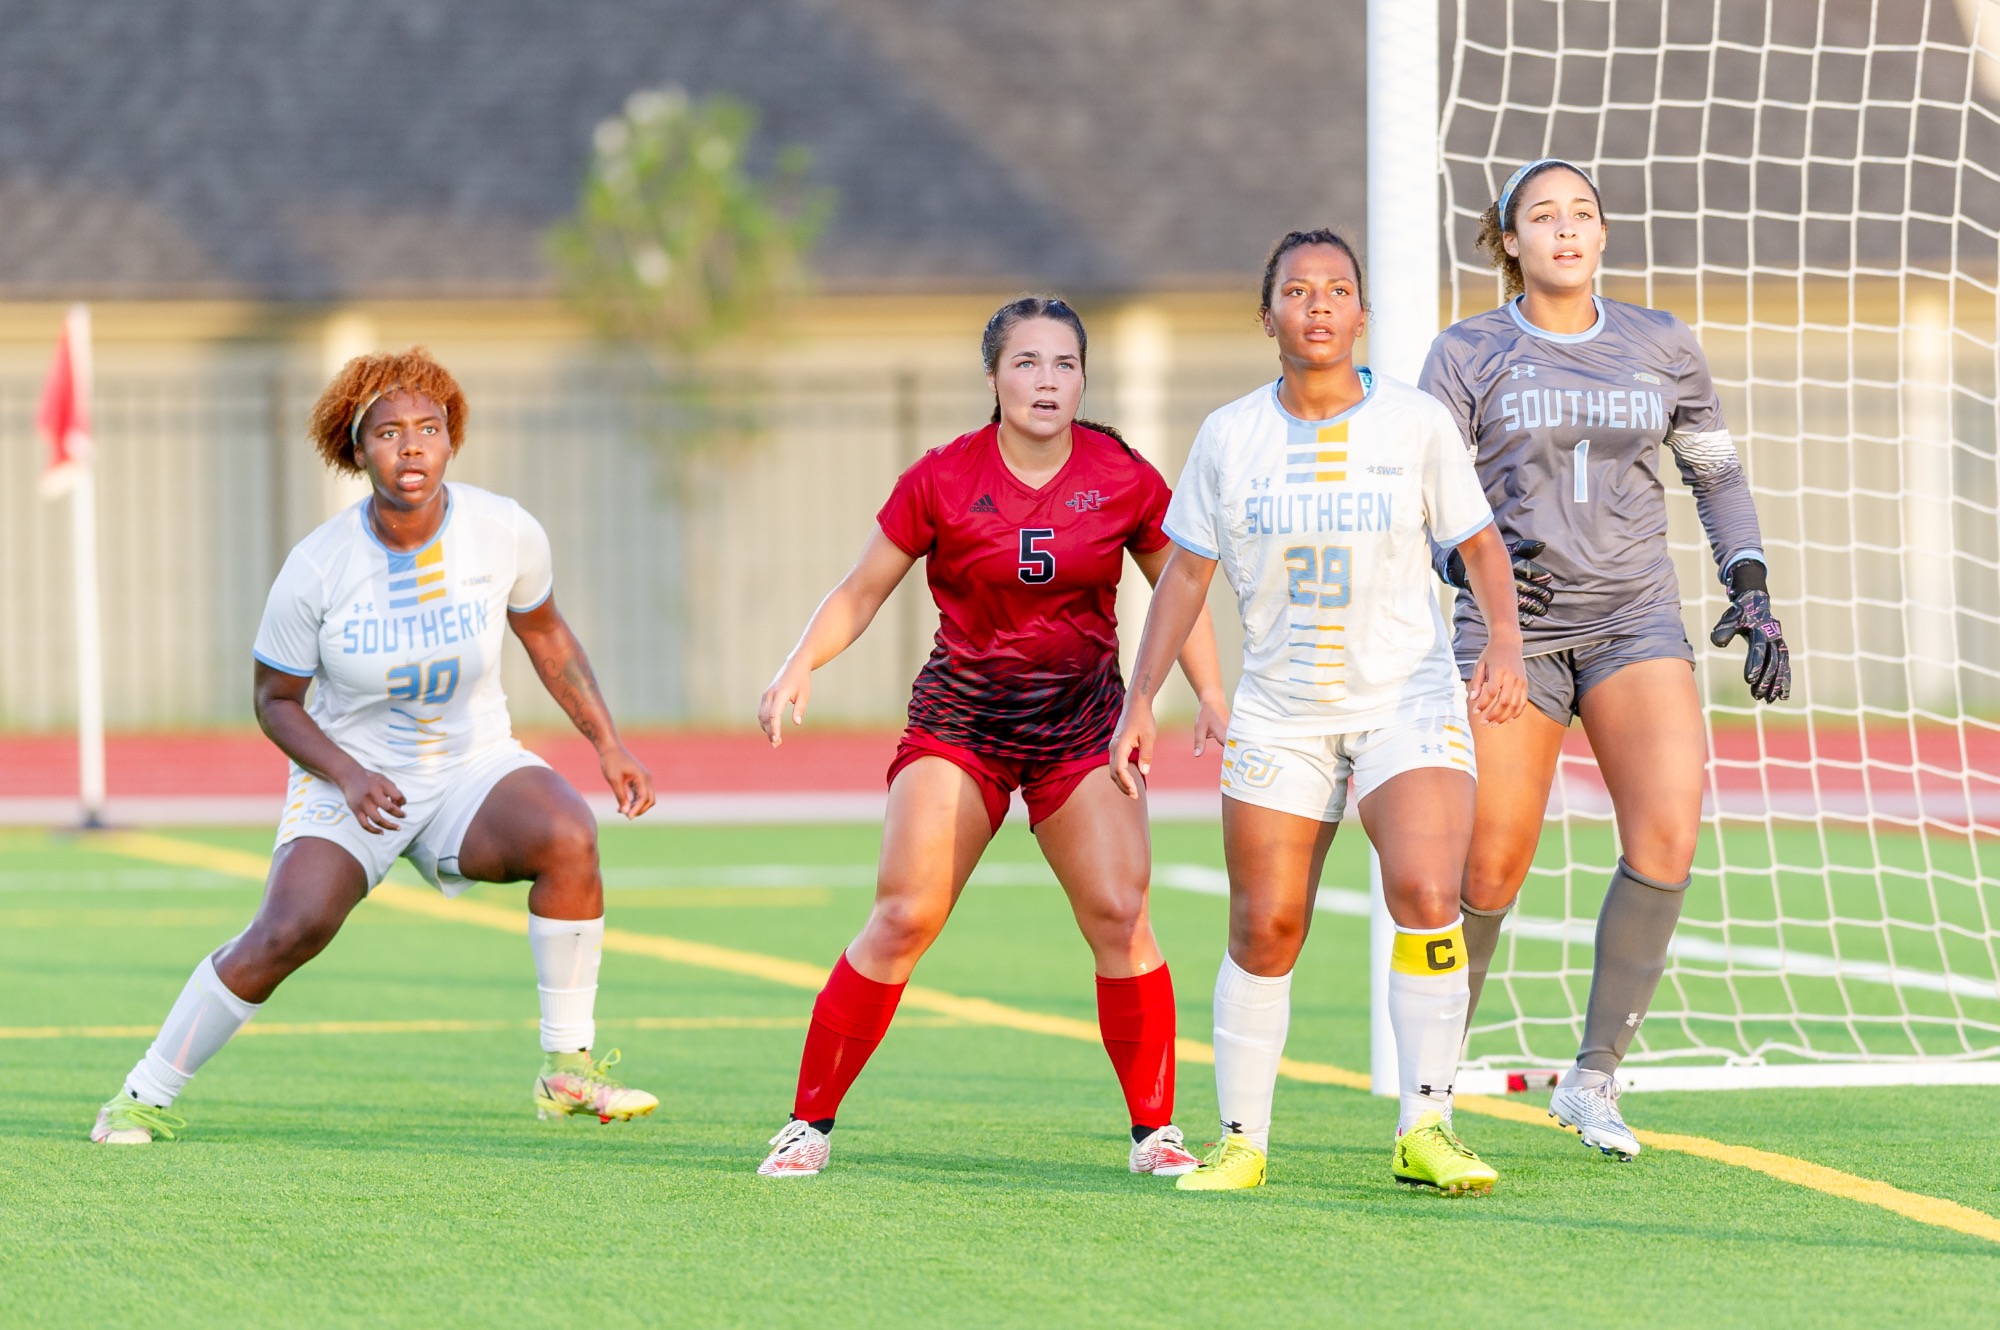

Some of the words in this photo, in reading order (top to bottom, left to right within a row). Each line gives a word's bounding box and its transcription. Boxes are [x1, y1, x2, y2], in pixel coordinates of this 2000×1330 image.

[1501, 388, 1664, 431] SOUTHERN
[1376, 465, 1404, 476] SWAC
[1573, 439, 1590, 503] 1
[1245, 493, 1392, 535] SOUTHERN
[1018, 528, 1056, 585] 5
[1283, 545, 1353, 609] 29
[342, 598, 488, 654] SOUTHERN
[1425, 938, 1456, 971] C
